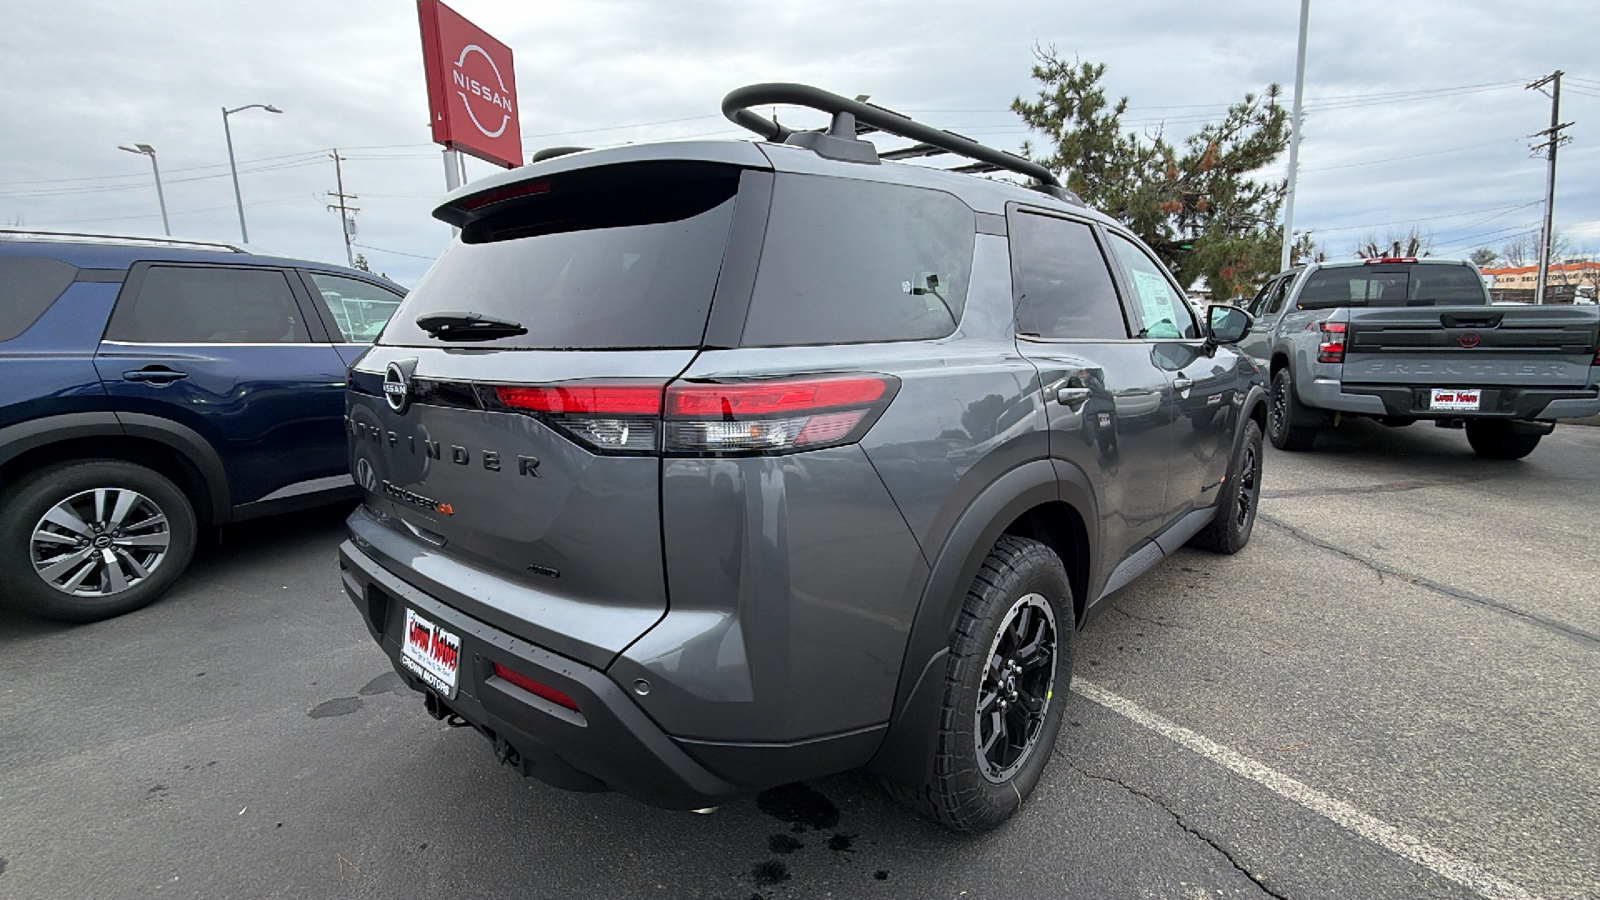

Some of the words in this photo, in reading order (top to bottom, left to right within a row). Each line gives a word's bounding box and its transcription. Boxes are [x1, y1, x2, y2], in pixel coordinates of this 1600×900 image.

[453, 69, 512, 113] NISSAN
[1547, 273, 1579, 281] TORAGE
[1365, 364, 1566, 377] FRONTIER
[383, 384, 406, 394] ISSAN
[402, 656, 424, 677] CROWN
[423, 669, 450, 696] MOTORS
